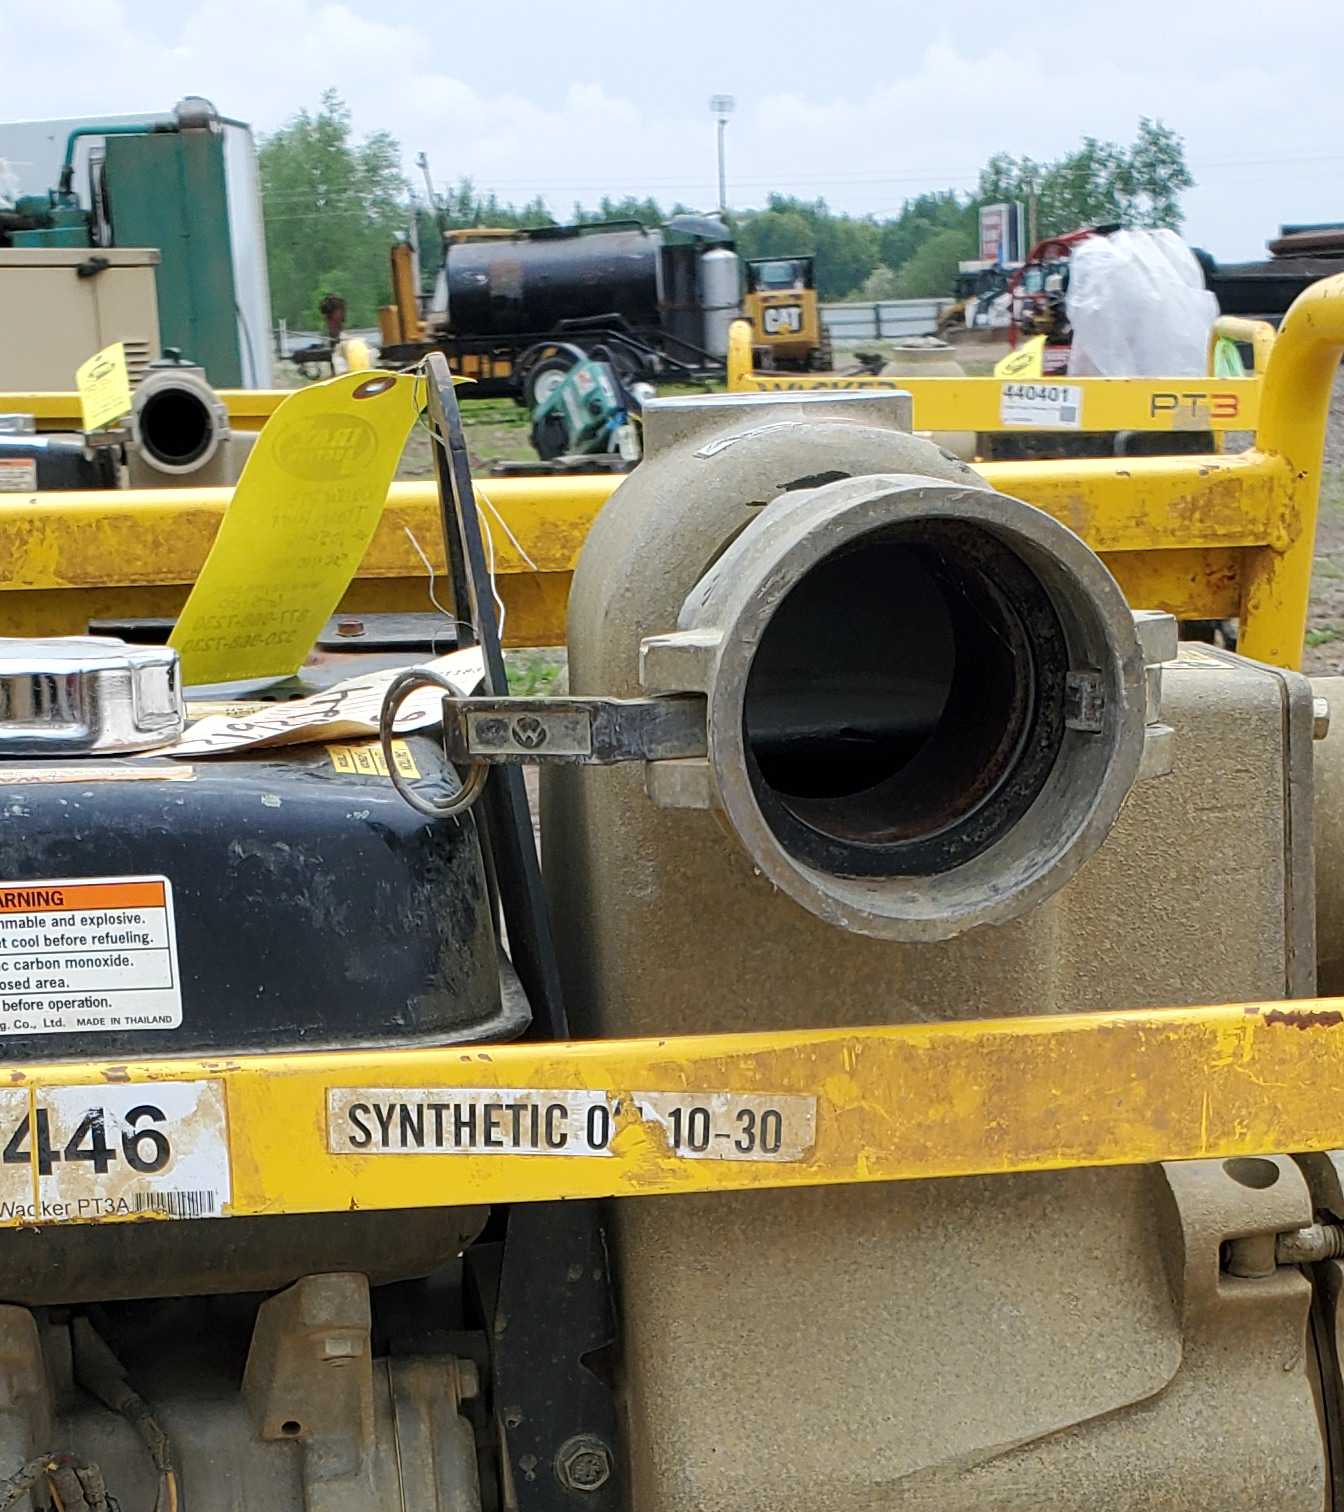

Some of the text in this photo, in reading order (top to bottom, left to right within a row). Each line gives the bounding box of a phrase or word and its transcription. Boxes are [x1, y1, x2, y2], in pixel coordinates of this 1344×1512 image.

[1150, 393, 1240, 418] PT3
[50, 914, 76, 928] and
[80, 911, 146, 928] explosive.
[11, 934, 40, 949] cool
[43, 932, 88, 947] before
[91, 931, 154, 946] refueling.
[13, 957, 61, 971] carbon
[64, 954, 135, 968] monoxide.
[35, 978, 70, 990] area.
[2, 998, 44, 1012] before
[47, 996, 112, 1011] operation.
[43, 1017, 66, 1029] Ltd.
[76, 1017, 106, 1027] MADE
[110, 1016, 121, 1025] IN
[124, 1015, 173, 1025] THAILAND
[348, 1102, 568, 1152] SYNTHETIC
[667, 1106, 783, 1154] 10-30
[77, 1197, 130, 1216] PT3A
